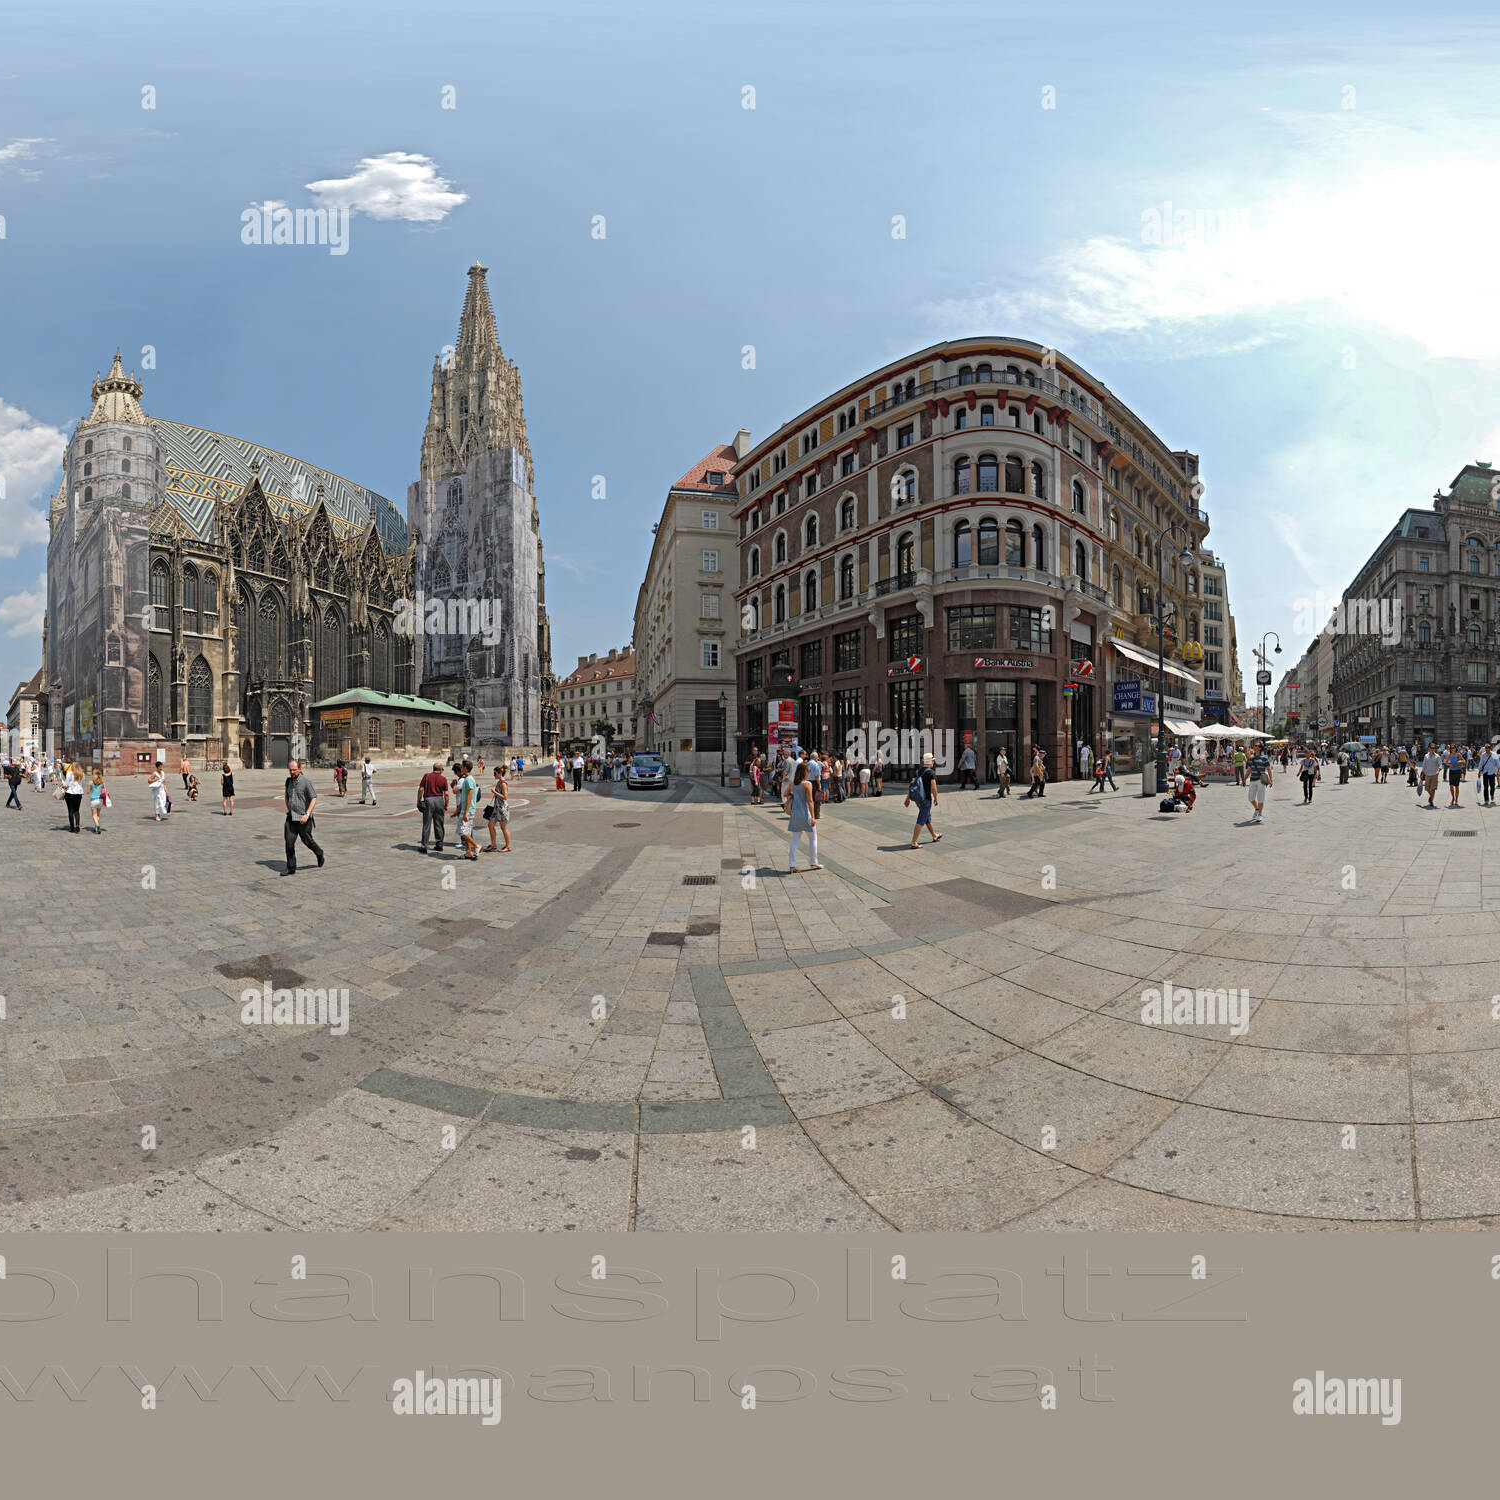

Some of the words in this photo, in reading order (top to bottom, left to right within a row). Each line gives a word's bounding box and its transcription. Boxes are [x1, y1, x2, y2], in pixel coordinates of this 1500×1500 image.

[984, 657, 1005, 667] Bank
[1007, 657, 1033, 667] Austria
[1114, 691, 1140, 700] CHANGE
